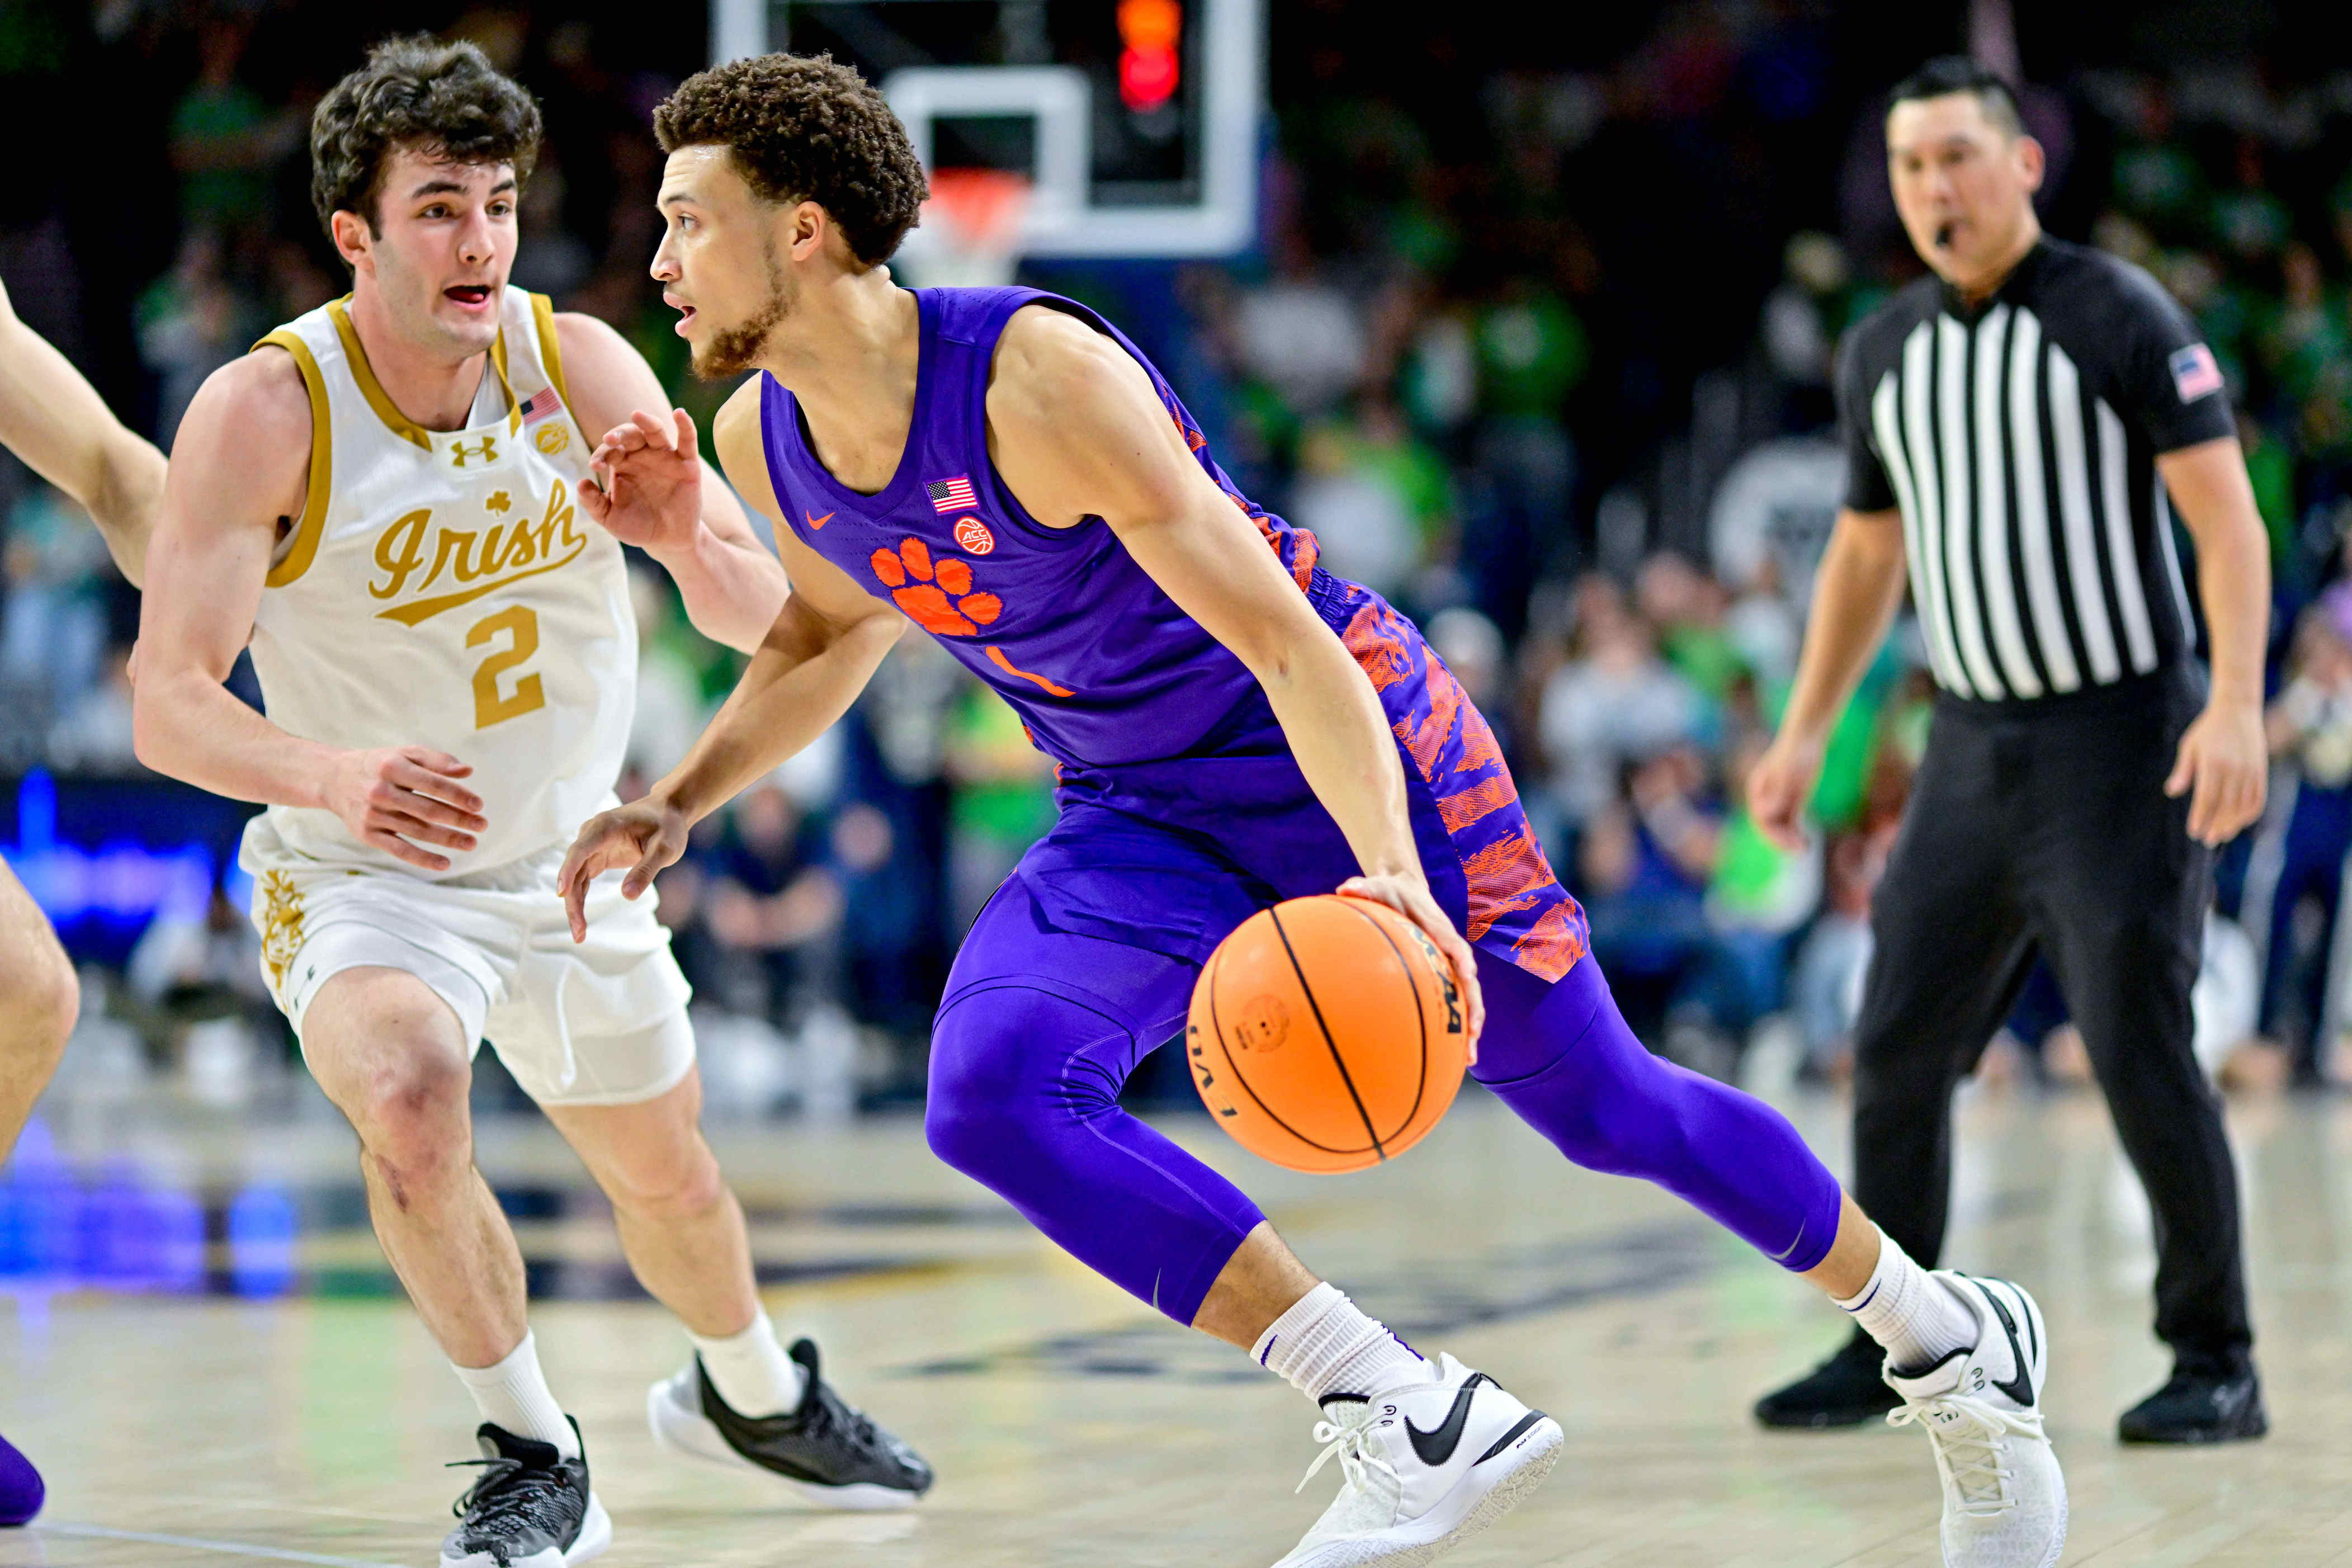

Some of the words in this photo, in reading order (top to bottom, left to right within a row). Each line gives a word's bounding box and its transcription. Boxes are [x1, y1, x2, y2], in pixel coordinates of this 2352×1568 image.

[369, 479, 587, 599] Irish
[962, 529, 987, 541] ACC
[466, 604, 545, 730] 2
